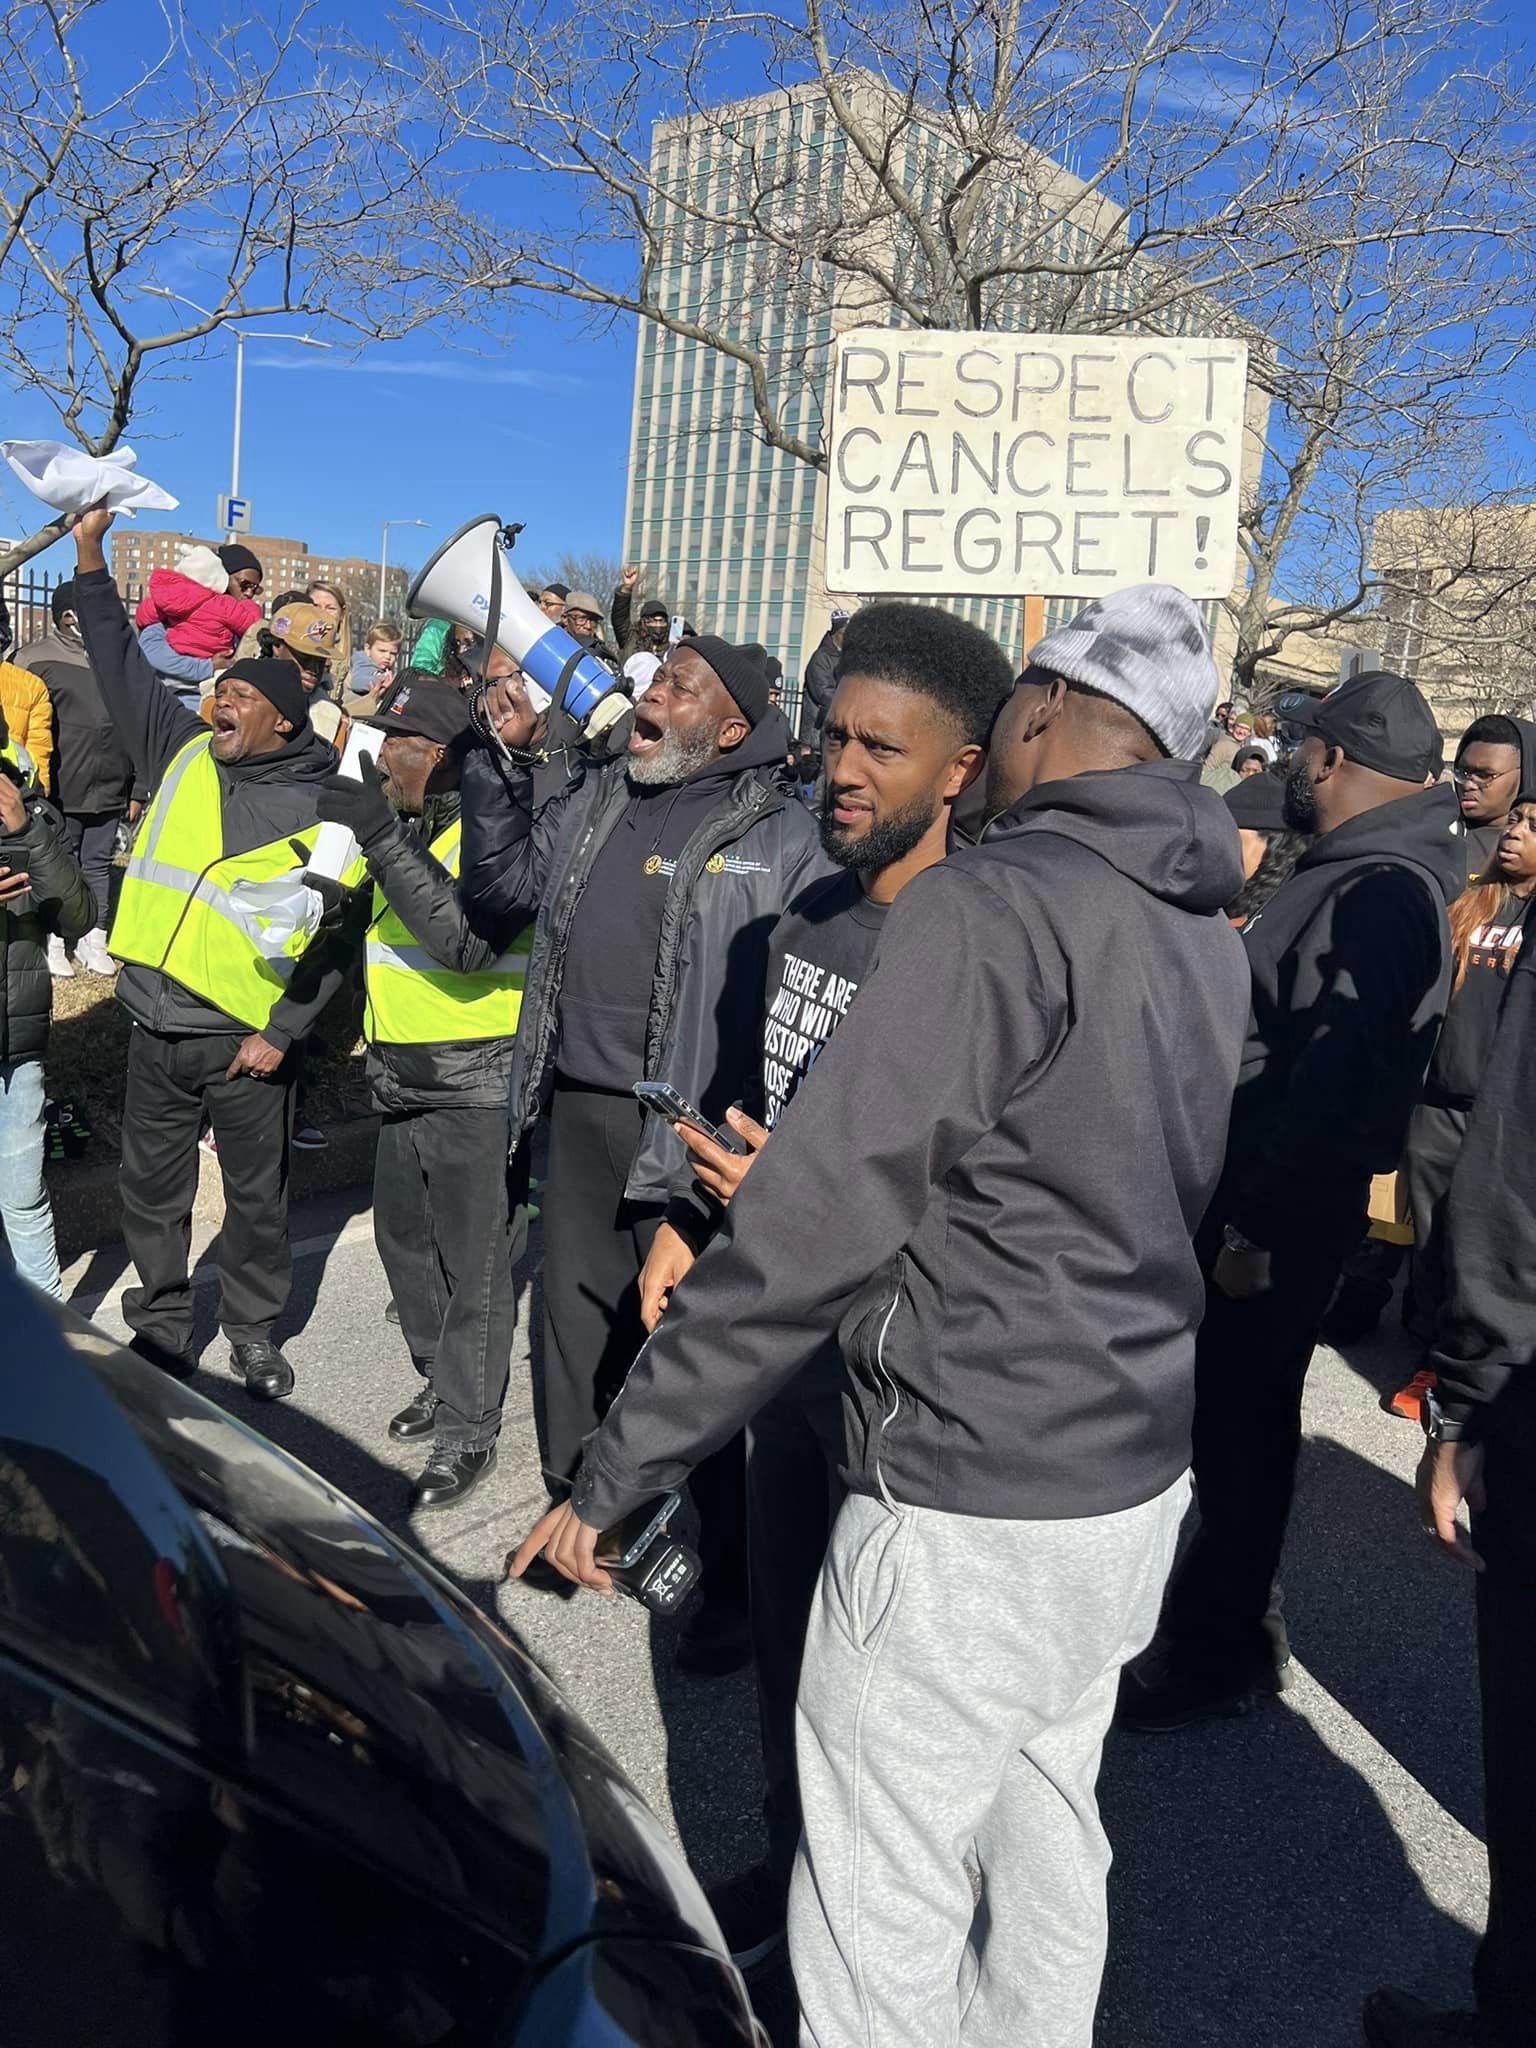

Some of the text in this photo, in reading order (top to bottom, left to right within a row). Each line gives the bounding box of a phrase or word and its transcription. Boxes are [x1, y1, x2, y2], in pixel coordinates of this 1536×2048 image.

[838, 346, 1238, 424] RESPECT
[837, 427, 1233, 498] CANCELS
[227, 499, 246, 527] F
[843, 505, 1211, 577] REGRET!
[769, 986, 801, 1026] WHO
[780, 953, 858, 1015] THERE ARE
[764, 1057, 794, 1101] OSE
